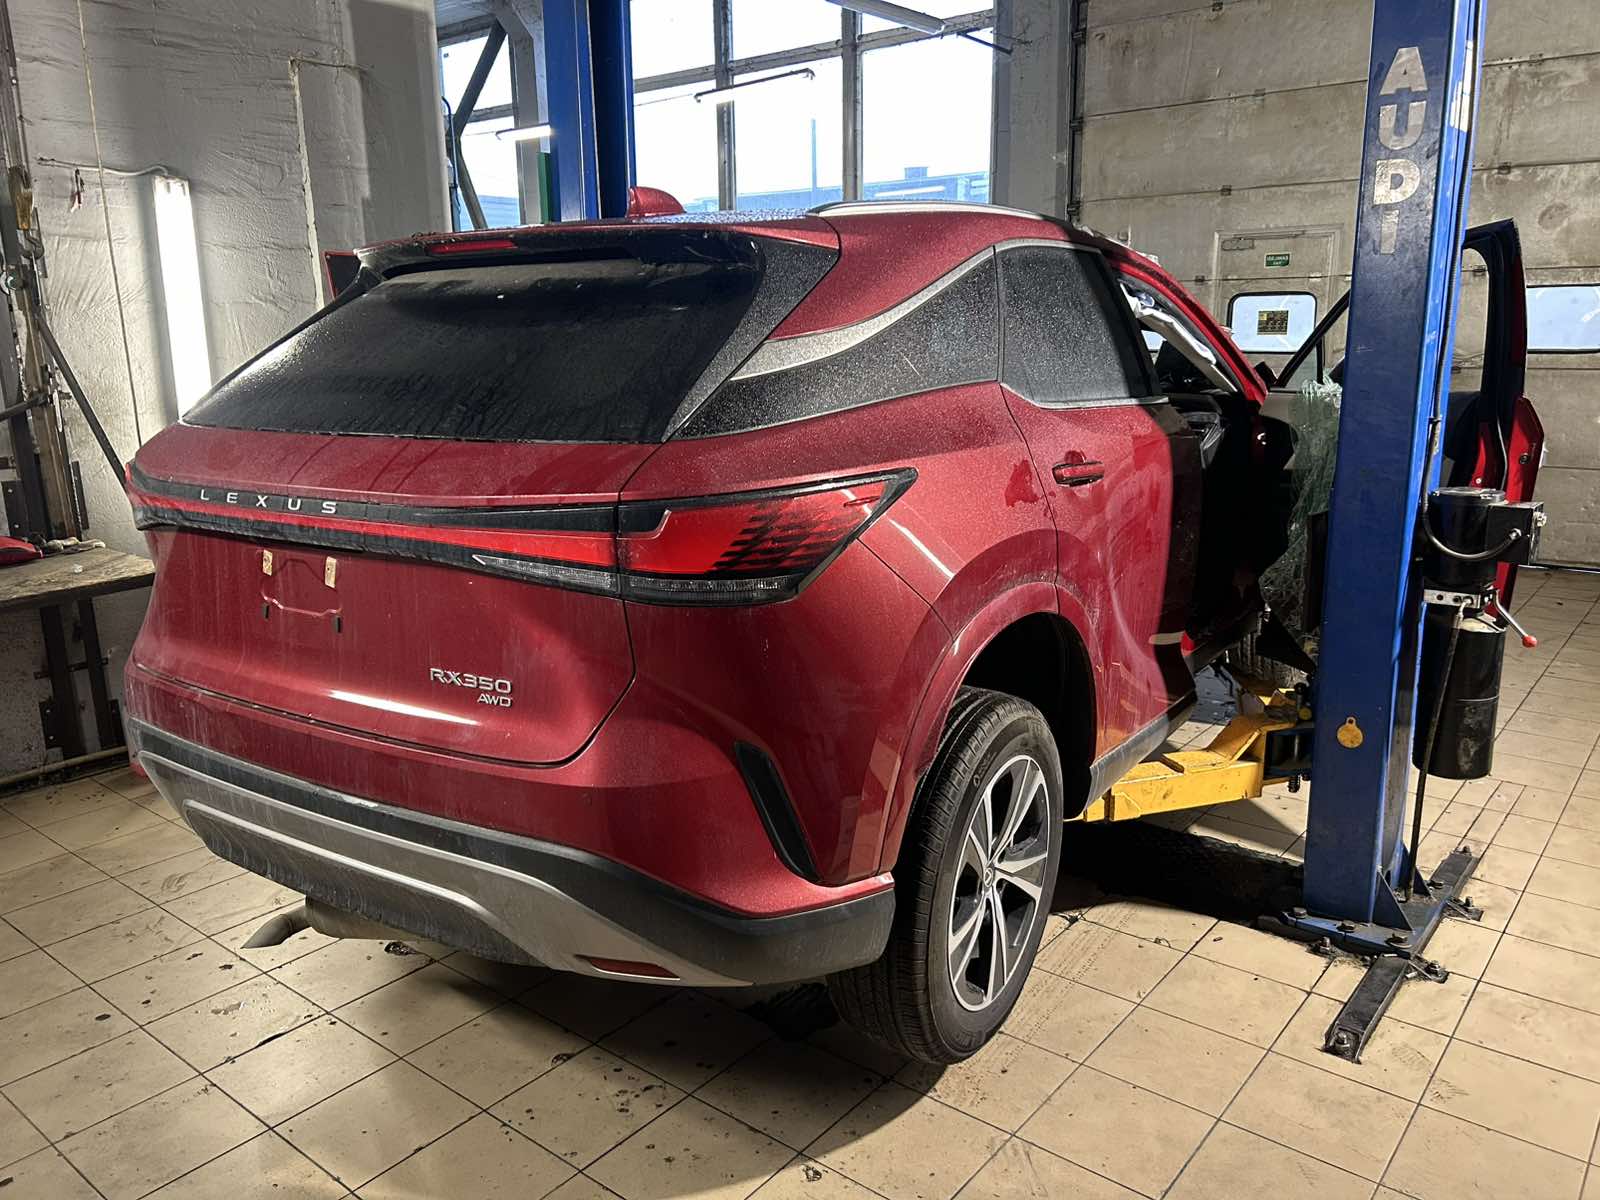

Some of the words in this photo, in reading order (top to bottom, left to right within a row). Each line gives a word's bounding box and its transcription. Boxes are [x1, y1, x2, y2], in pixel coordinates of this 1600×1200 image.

[1373, 46, 1428, 254] AUDI
[200, 489, 337, 514] LEXUS
[429, 667, 512, 694] RX350
[476, 693, 512, 707] AWD
